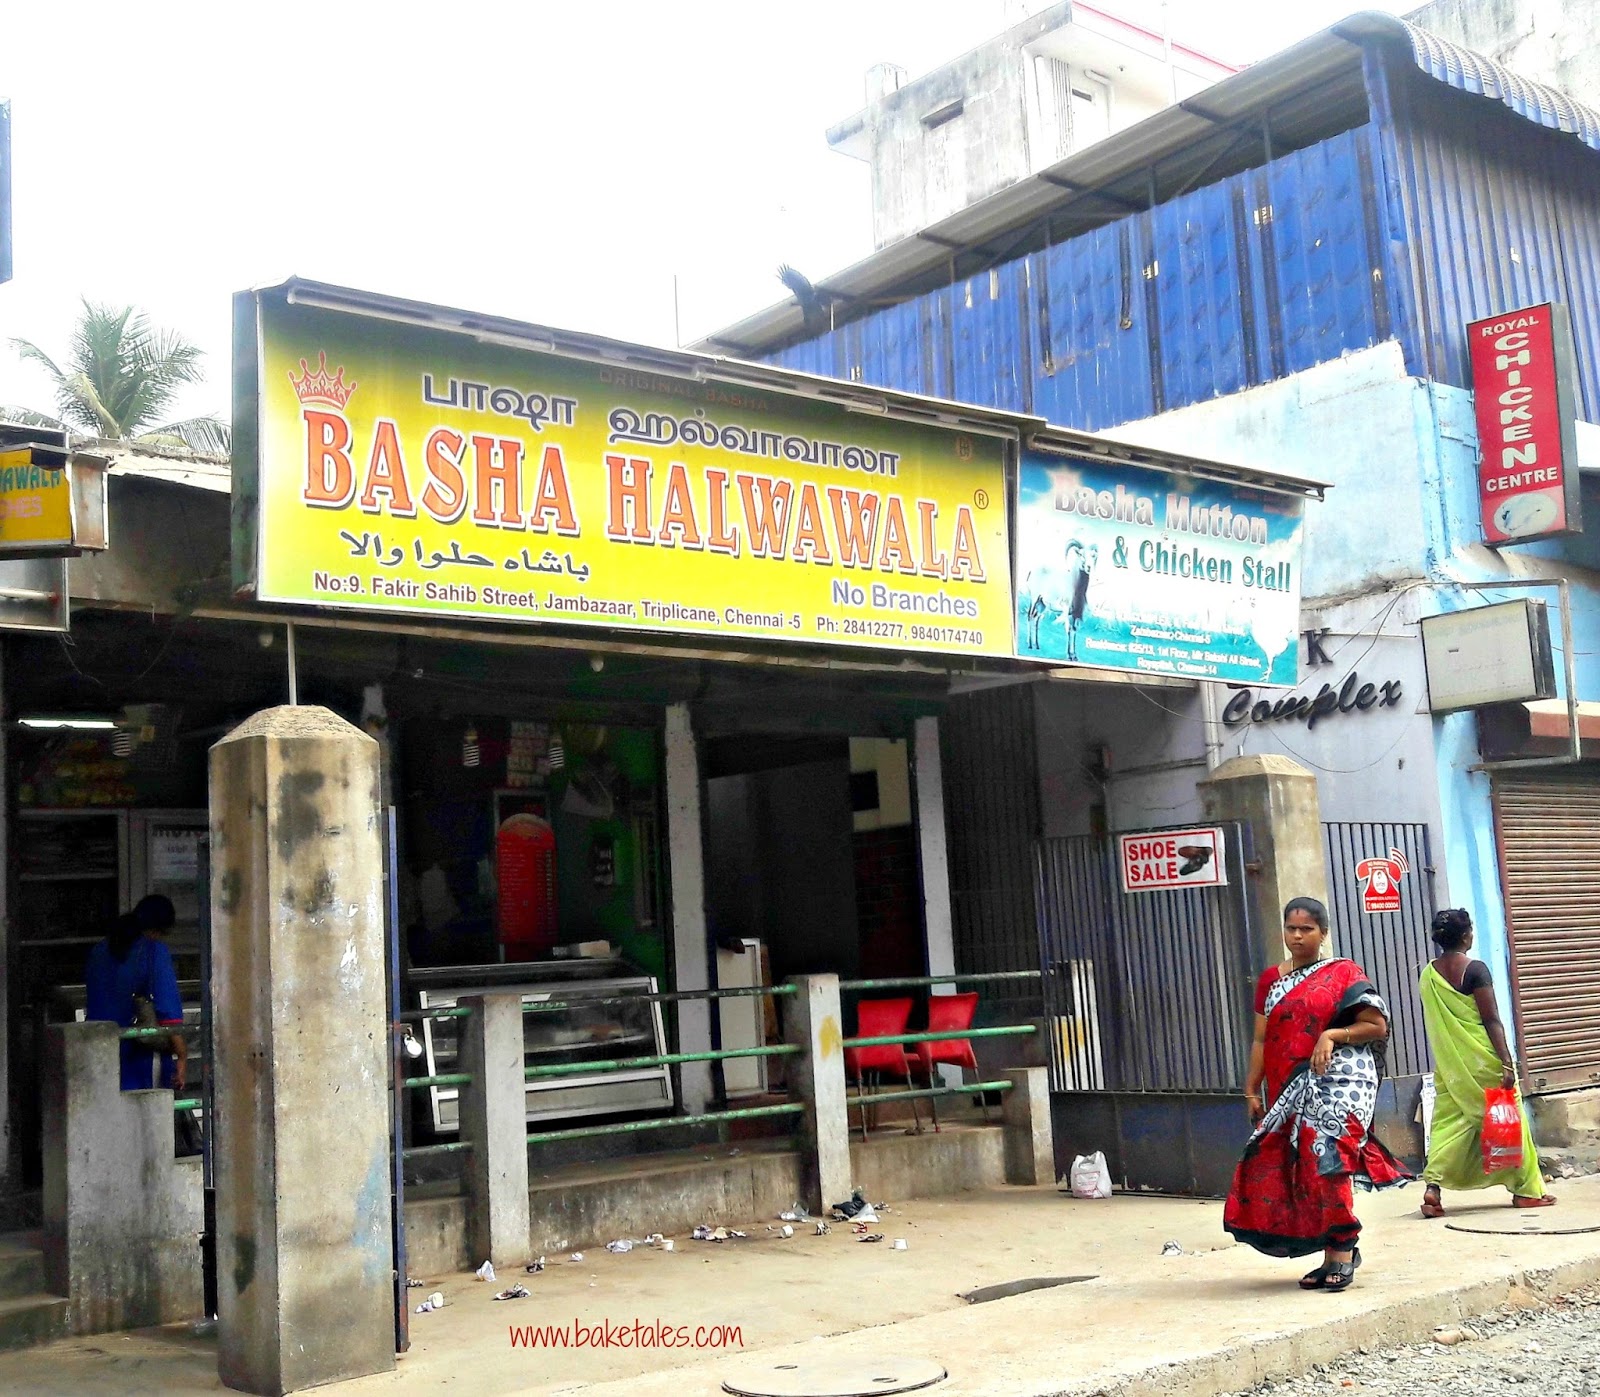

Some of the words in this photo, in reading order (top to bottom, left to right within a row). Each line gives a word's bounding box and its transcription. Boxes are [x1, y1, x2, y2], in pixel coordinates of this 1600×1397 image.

[1481, 315, 1540, 337] ROYAL
[423, 375, 578, 431] பாஷா
[609, 407, 899, 477] ஹல்வாவாலா
[1494, 332, 1537, 470] CHICKEN
[303, 410, 580, 537] BASHA
[605, 455, 986, 583] HALWAWALA
[1485, 467, 1559, 493] CENTRE
[1053, 480, 1155, 527] Basha
[1165, 492, 1268, 545] Mutton
[1112, 535, 1129, 569] &
[1138, 539, 1233, 584] Chicken
[1241, 555, 1292, 592] Stall
[372, 577, 420, 599] Fakir
[425, 582, 477, 604] Sahib
[482, 587, 539, 610] Street,
[544, 593, 637, 619] Jambazaar,
[641, 601, 720, 625] Triplicane,
[724, 608, 784, 629] Chennai
[788, 615, 801, 629] -5
[816, 617, 839, 633] Ph:
[843, 619, 908, 640] 28412277,
[911, 625, 983, 645] 9840174740
[832, 580, 864, 605] No
[872, 584, 978, 617] Branches
[1305, 626, 1334, 667] K
[1221, 671, 1403, 730] Complex
[1128, 840, 1177, 862] SHOE
[1130, 861, 1179, 884] SALE
